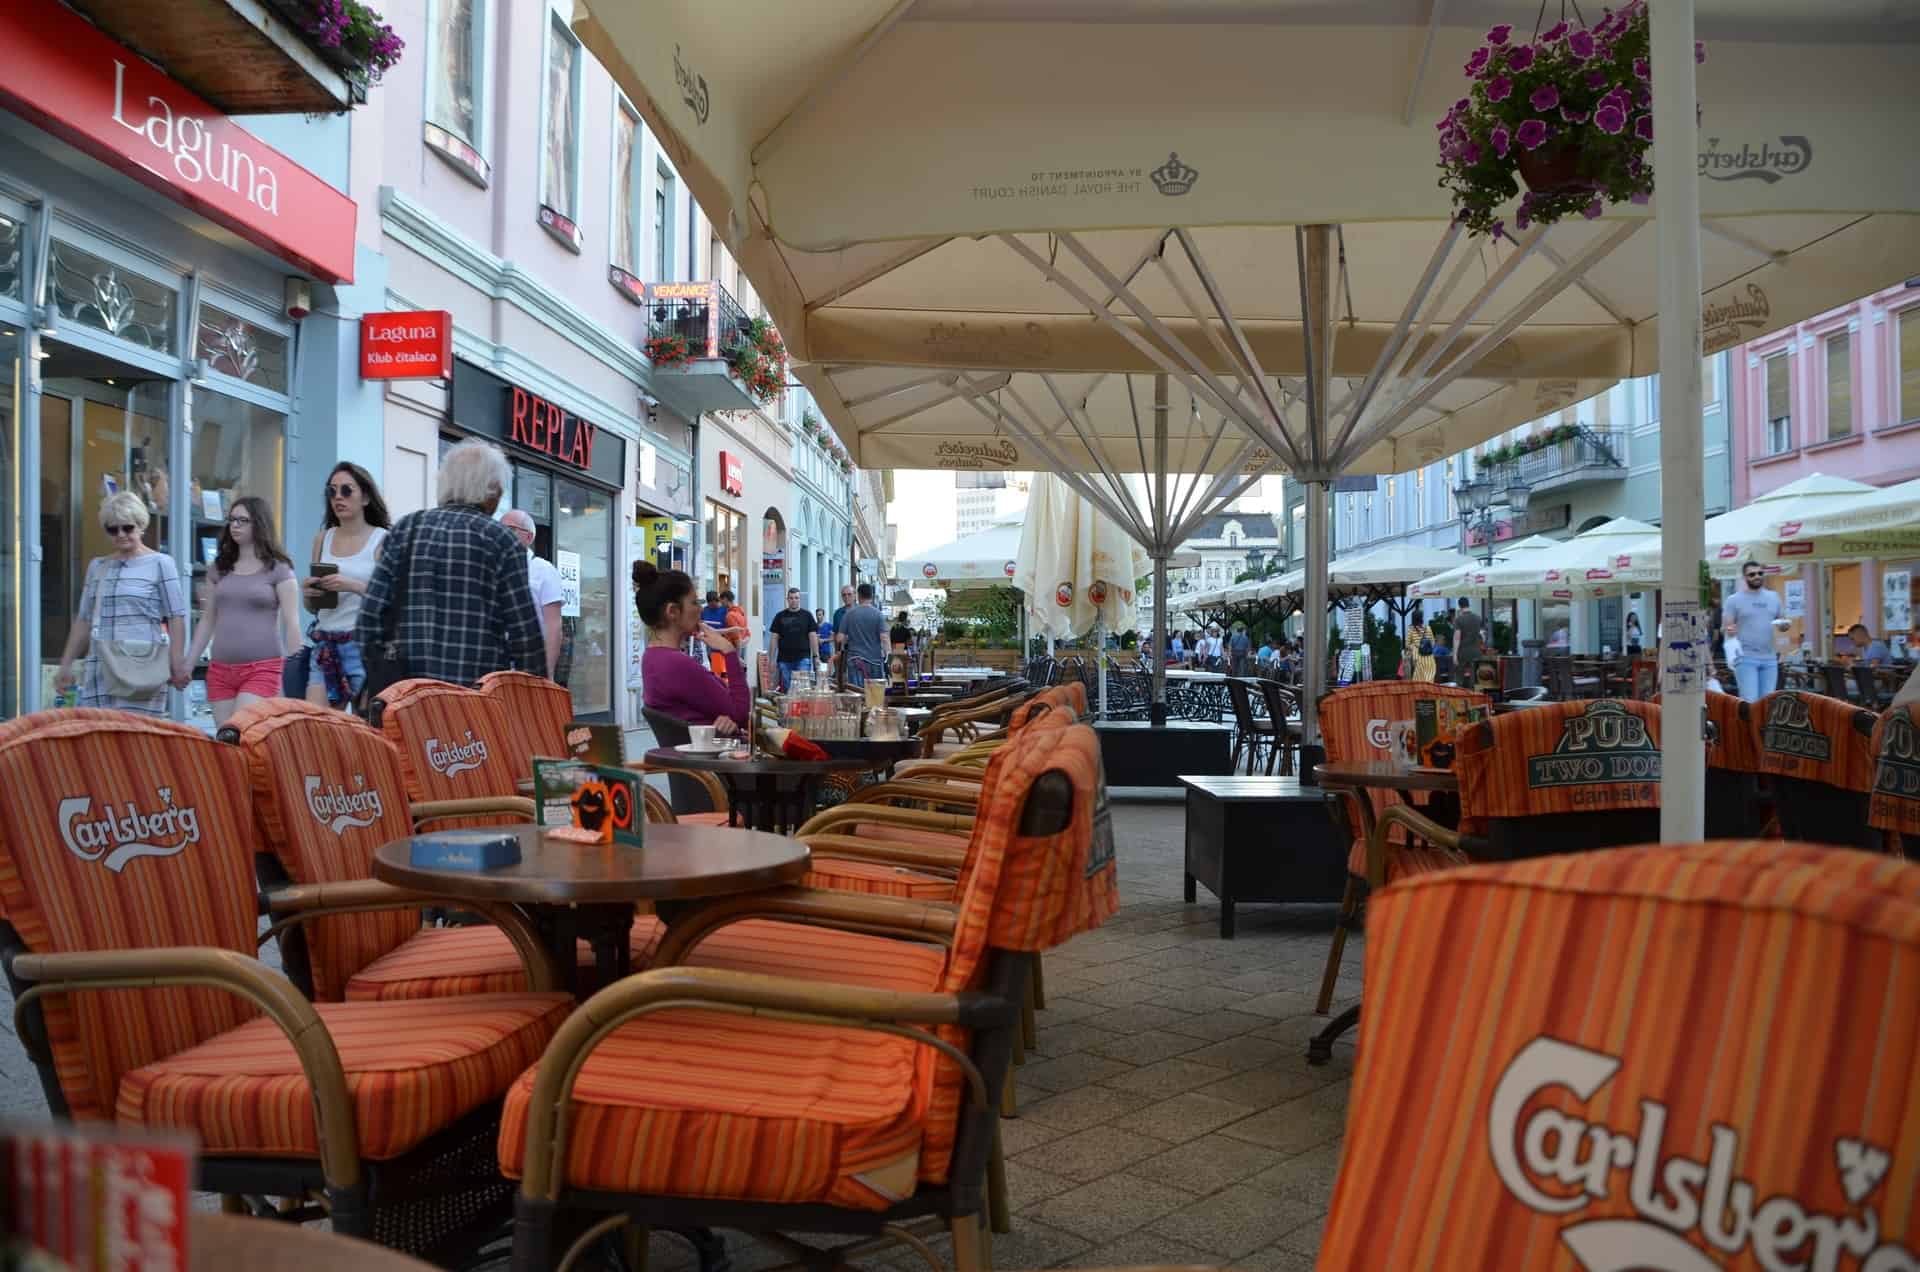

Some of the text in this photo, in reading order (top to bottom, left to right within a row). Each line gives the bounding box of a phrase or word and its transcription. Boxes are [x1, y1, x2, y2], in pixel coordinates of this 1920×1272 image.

[112, 59, 279, 217] Laguna
[369, 326, 437, 343] Laguna
[367, 352, 393, 364] Klub
[512, 387, 596, 470] REPLAY
[1565, 713, 1646, 751] PUB
[425, 738, 487, 778] Carlsberg
[1535, 755, 1662, 782] TWO DOG
[304, 775, 383, 836] Carlsberg
[57, 796, 201, 873] Carlsberg
